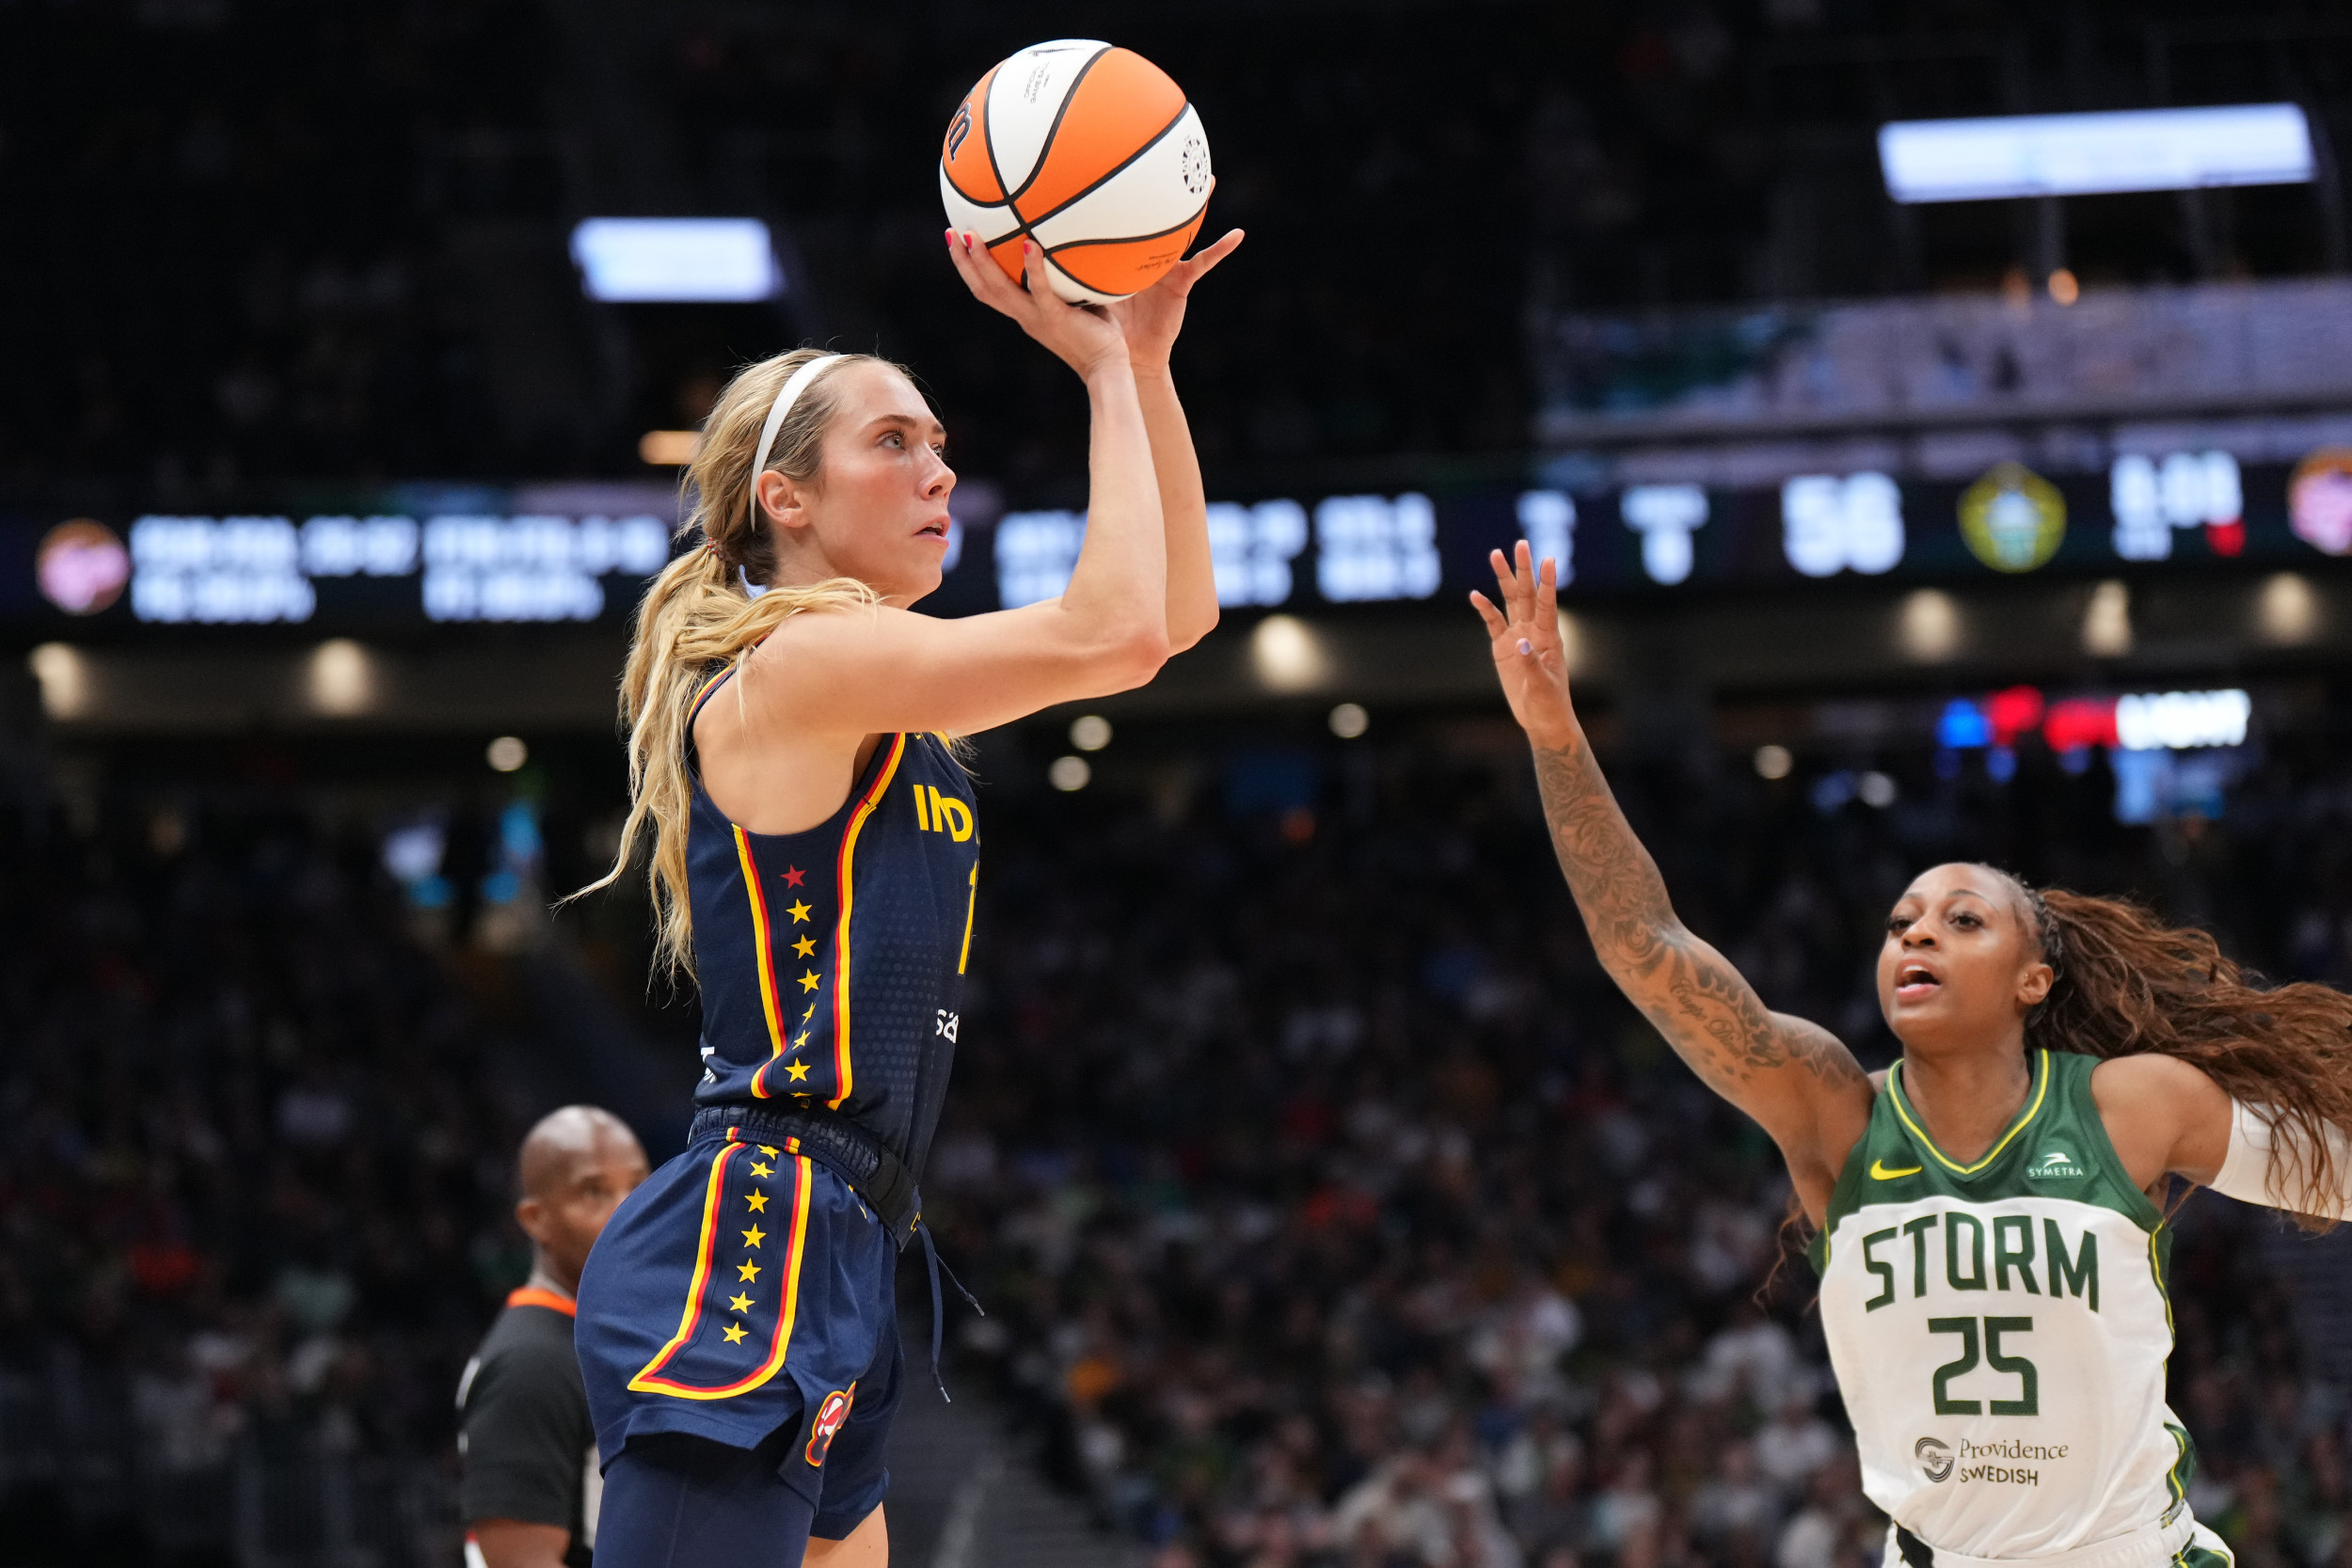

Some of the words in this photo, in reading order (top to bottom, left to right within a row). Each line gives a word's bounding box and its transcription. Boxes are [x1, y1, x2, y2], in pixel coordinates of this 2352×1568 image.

[914, 784, 979, 844] IND
[2028, 1166, 2085, 1179] SYMETRA
[1863, 1212, 2099, 1313] STORM
[1928, 1316, 2039, 1417] 25
[1960, 1438, 2069, 1461] Providence
[1959, 1464, 2039, 1487] SWEDISH
